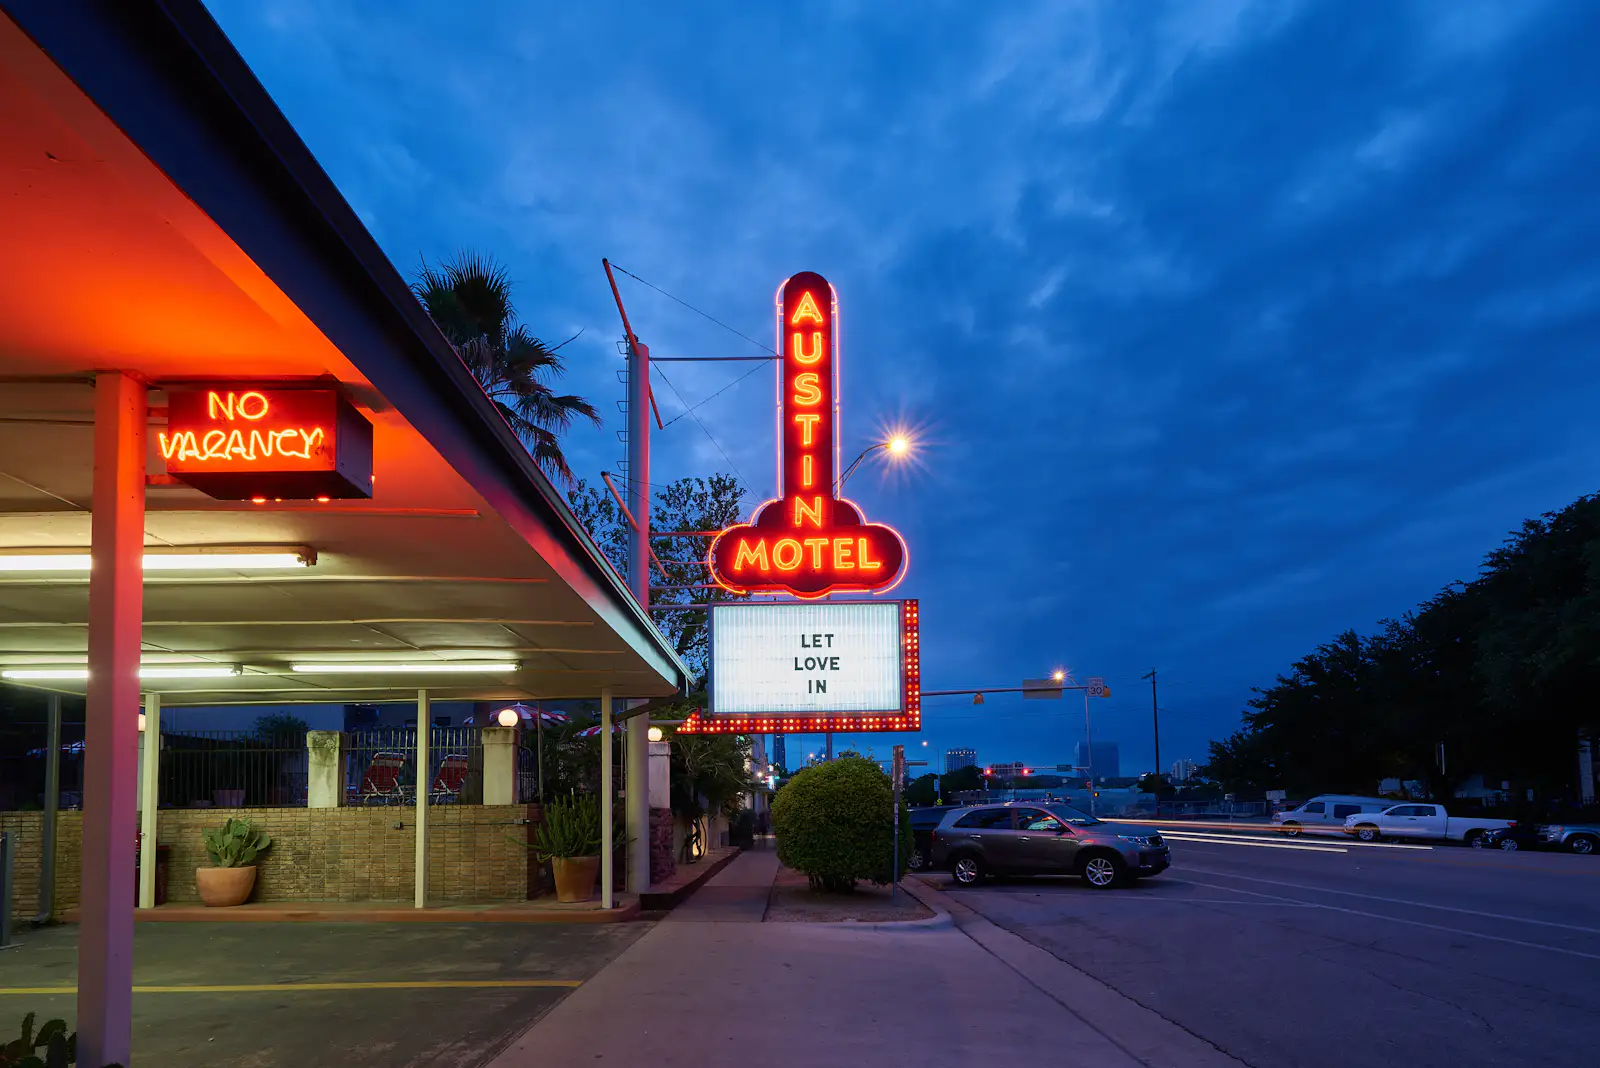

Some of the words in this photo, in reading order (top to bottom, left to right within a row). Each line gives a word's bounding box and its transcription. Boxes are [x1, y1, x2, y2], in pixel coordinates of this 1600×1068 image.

[208, 391, 269, 420] NO
[791, 291, 823, 528] AUSTIN
[158, 427, 325, 461] VACANCY
[734, 538, 881, 571] MOTEL
[801, 633, 834, 648] LET
[794, 656, 840, 671] LOVE
[808, 679, 827, 694] IN
[1090, 686, 1102, 695] 30
